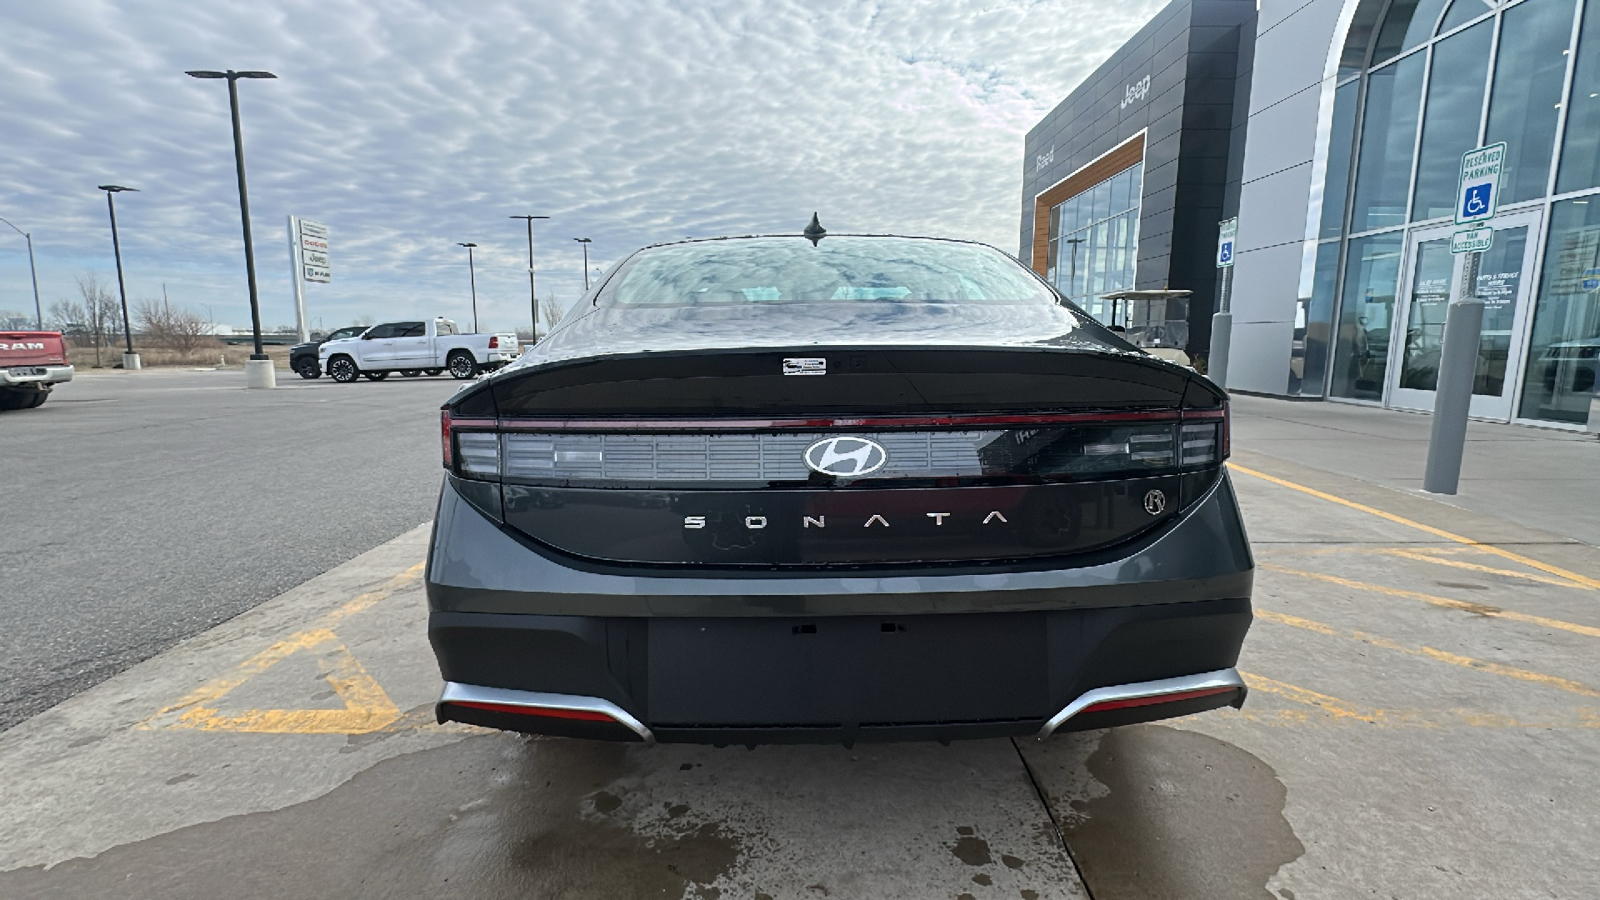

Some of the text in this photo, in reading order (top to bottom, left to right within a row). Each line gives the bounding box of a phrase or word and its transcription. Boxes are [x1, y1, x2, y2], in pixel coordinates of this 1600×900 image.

[1120, 75, 1150, 109] Jeep
[1465, 151, 1500, 168] RESERVED
[1463, 164, 1499, 180] PARKING
[1466, 232, 1478, 240] VAN
[1453, 239, 1489, 250] ACCESSIBLE
[310, 253, 326, 265] Jeep
[684, 510, 1007, 529] SONATA
